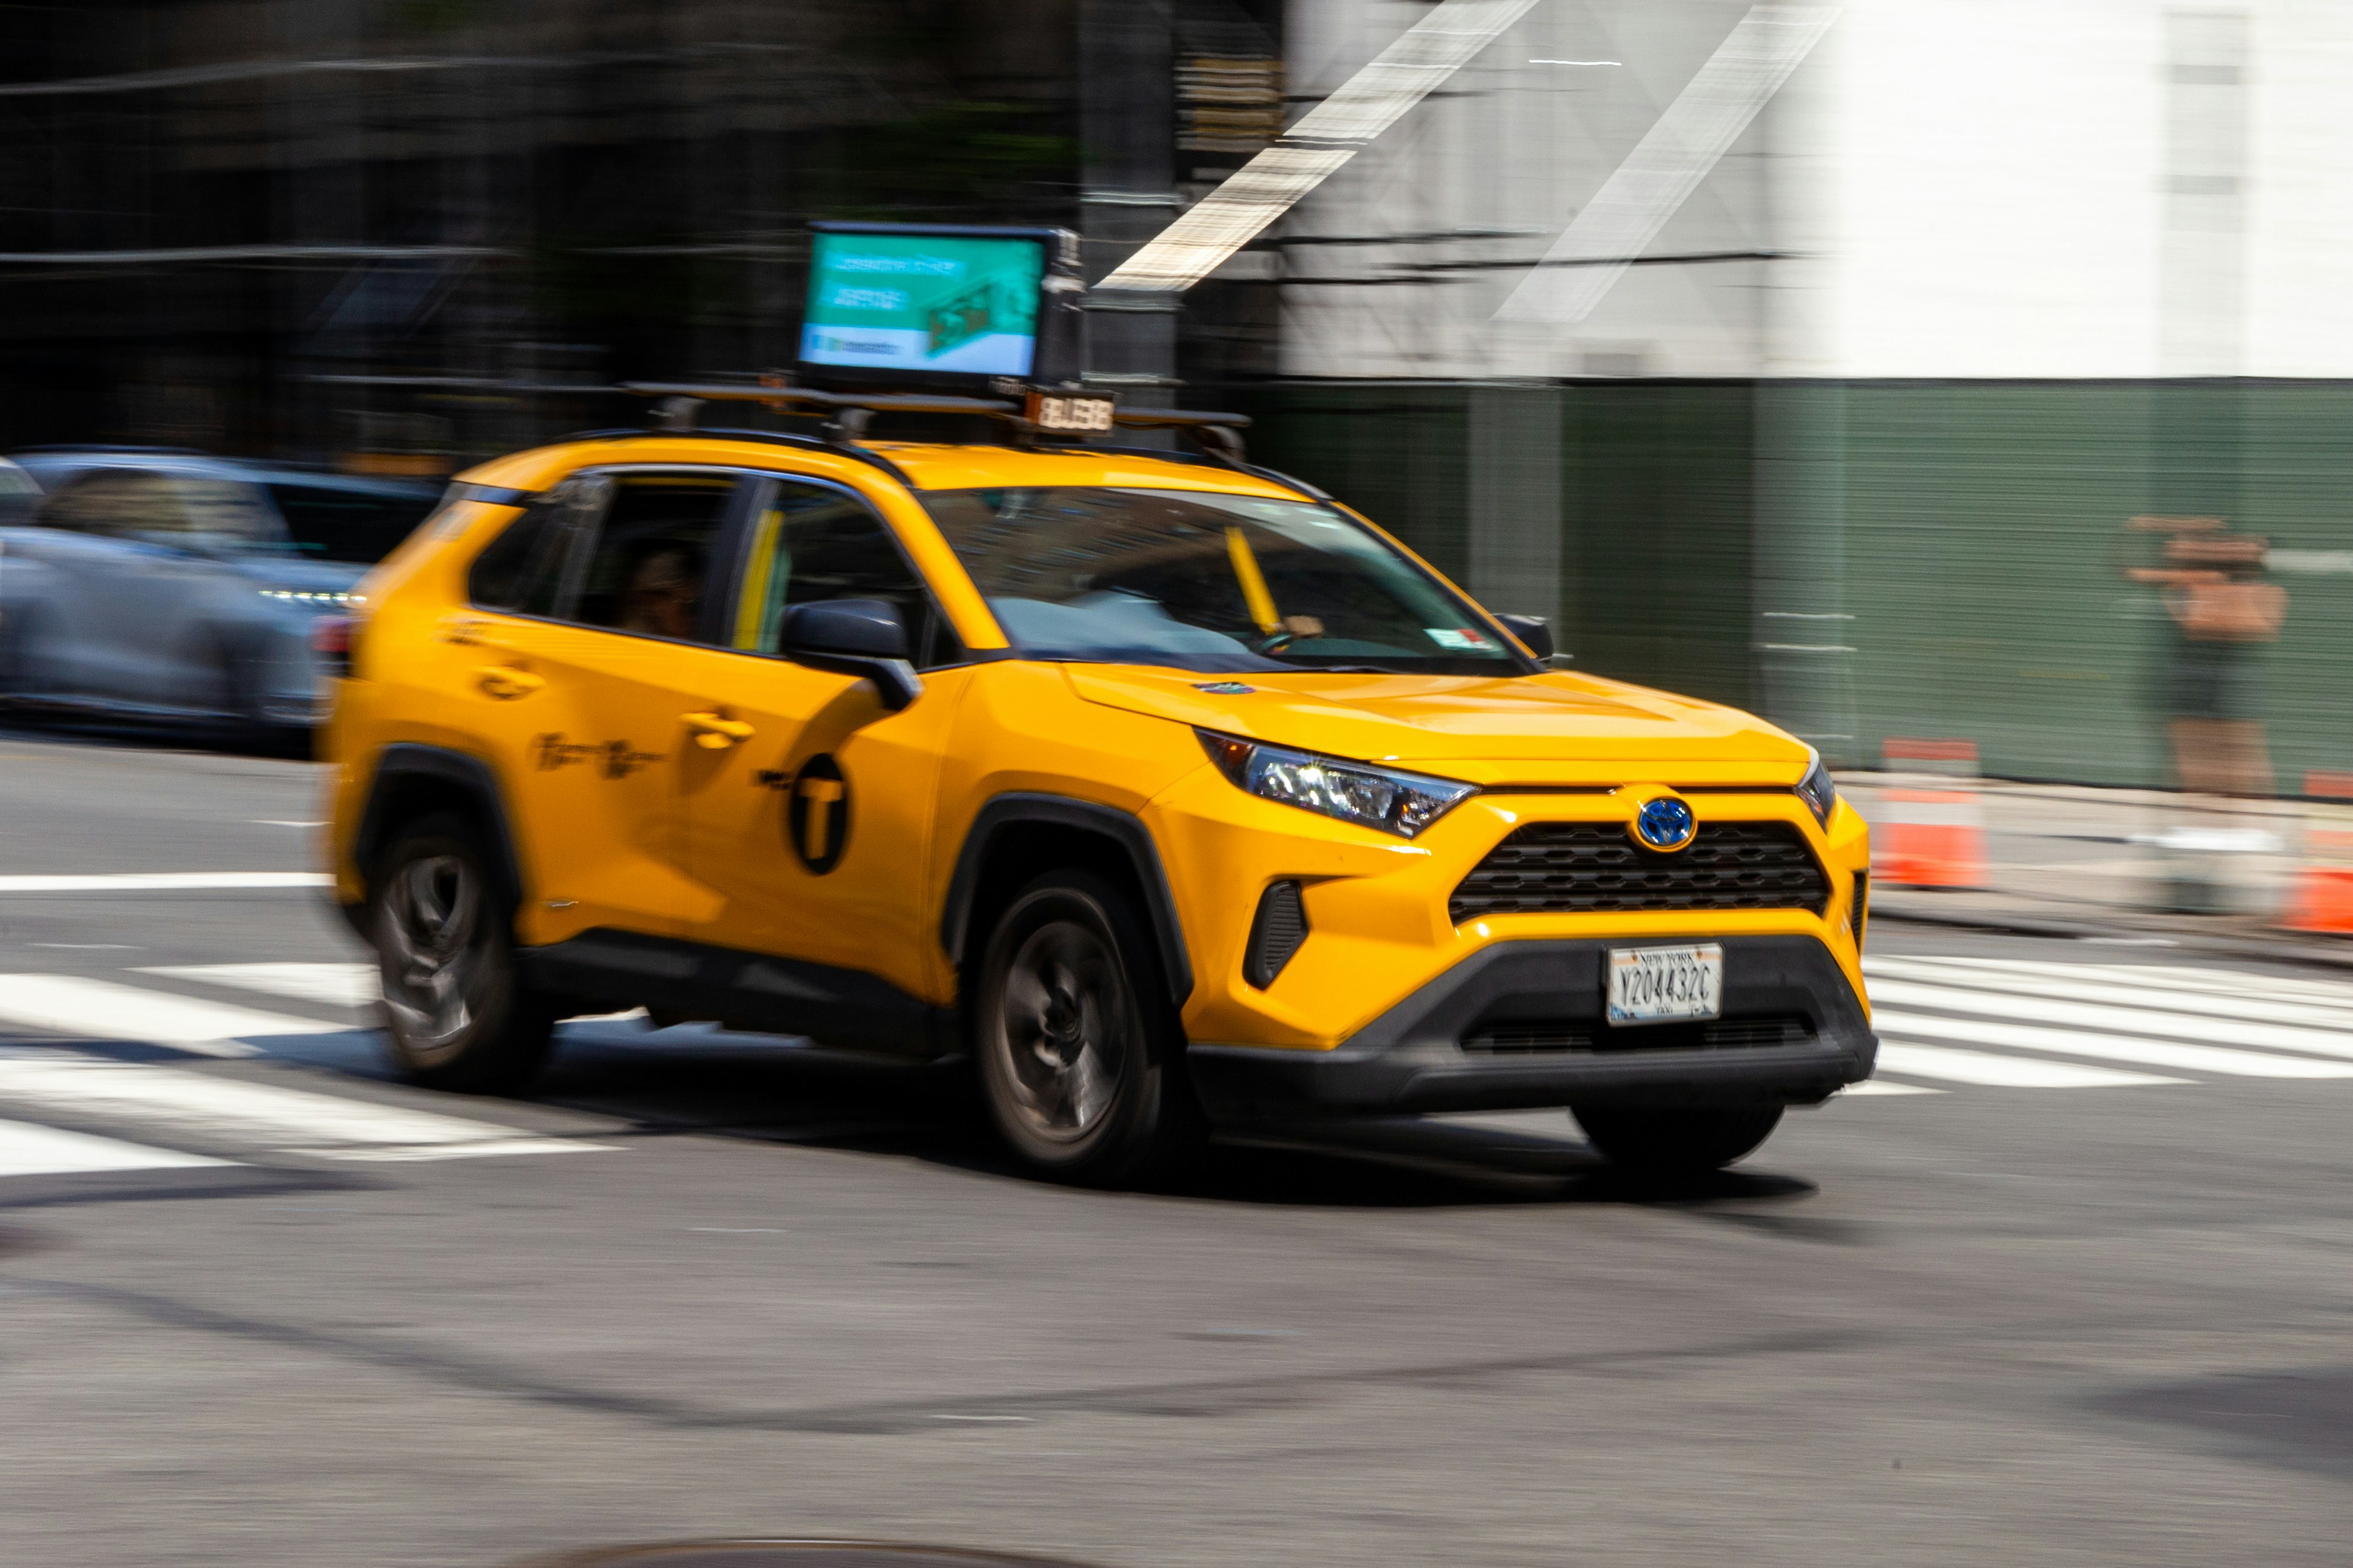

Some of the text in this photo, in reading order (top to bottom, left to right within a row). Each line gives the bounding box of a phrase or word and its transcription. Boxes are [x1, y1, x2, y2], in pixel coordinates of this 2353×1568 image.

[1640, 952, 1695, 967] NEW YORK
[1655, 1004, 1674, 1016] TAXI
